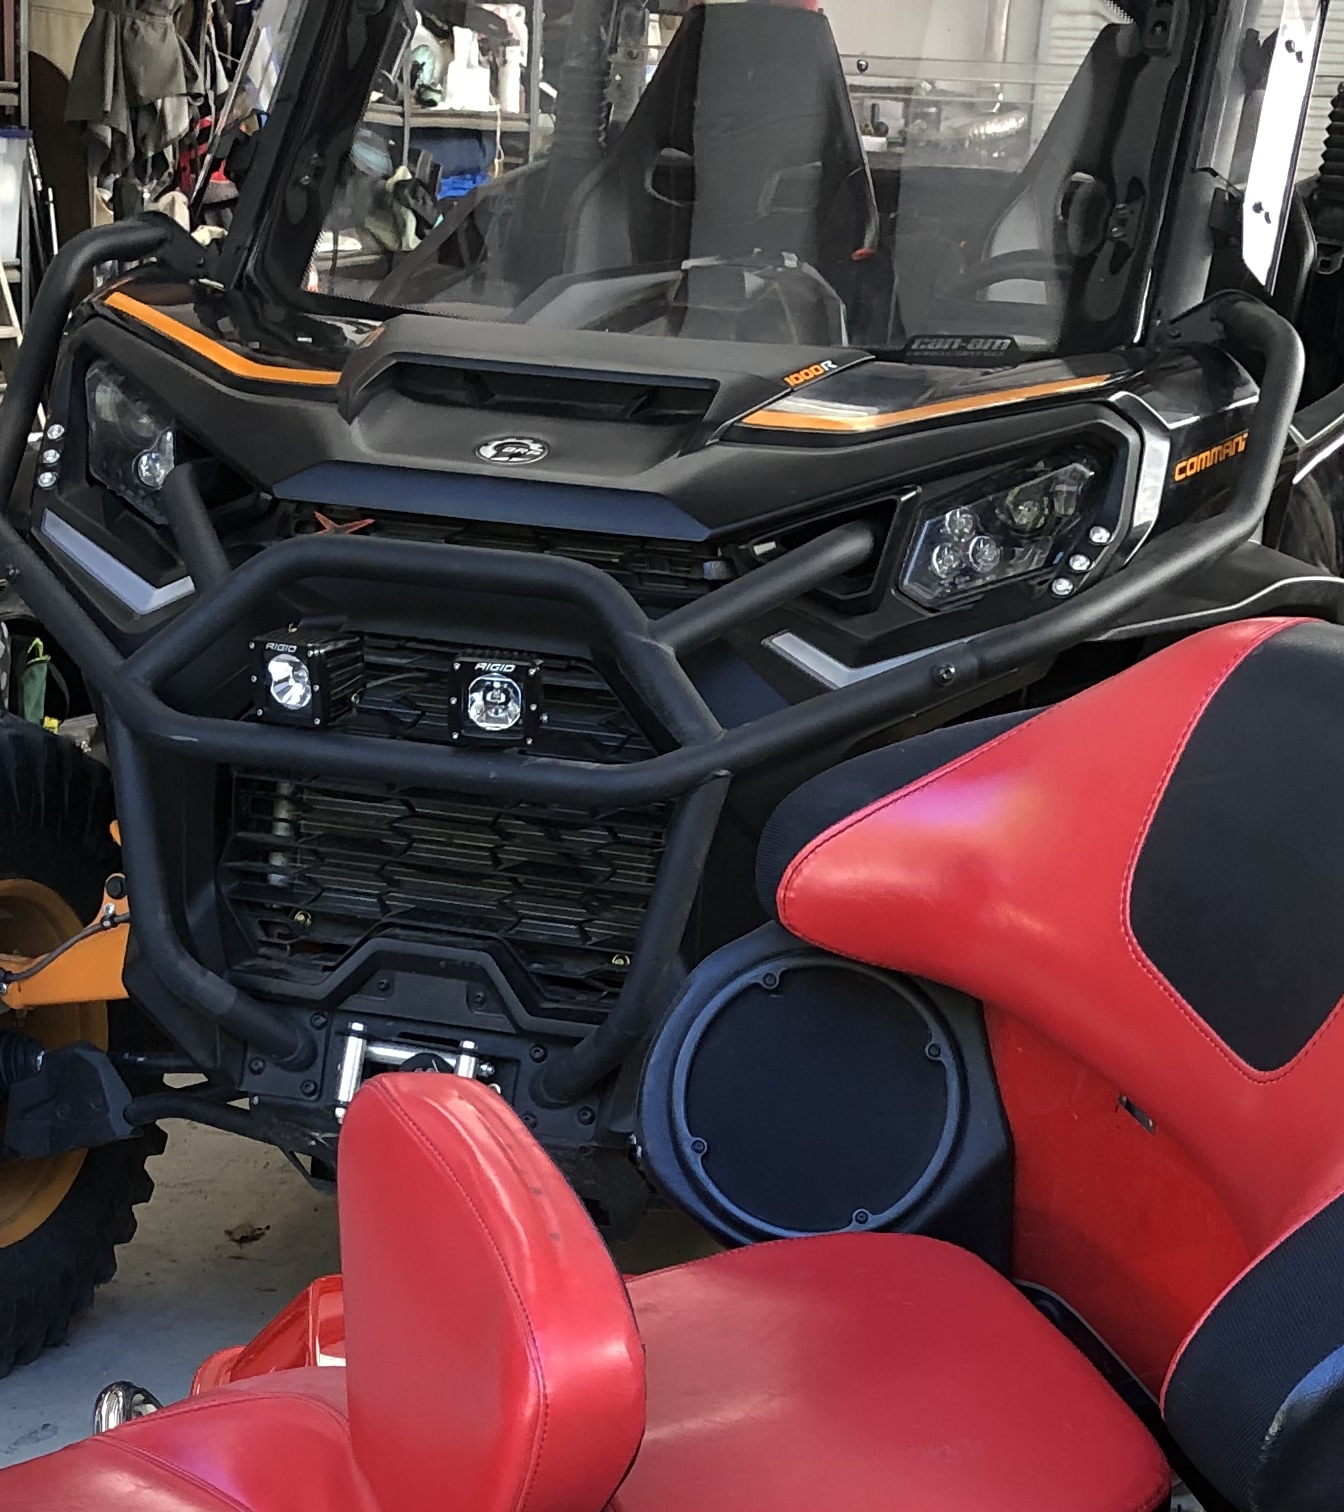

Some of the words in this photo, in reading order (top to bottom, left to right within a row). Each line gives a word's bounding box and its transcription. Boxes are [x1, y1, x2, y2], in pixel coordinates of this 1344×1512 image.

[910, 337, 1012, 351] can-am
[783, 359, 838, 386] 1000R
[265, 642, 298, 653] RIGID
[474, 662, 516, 673] RIGID
